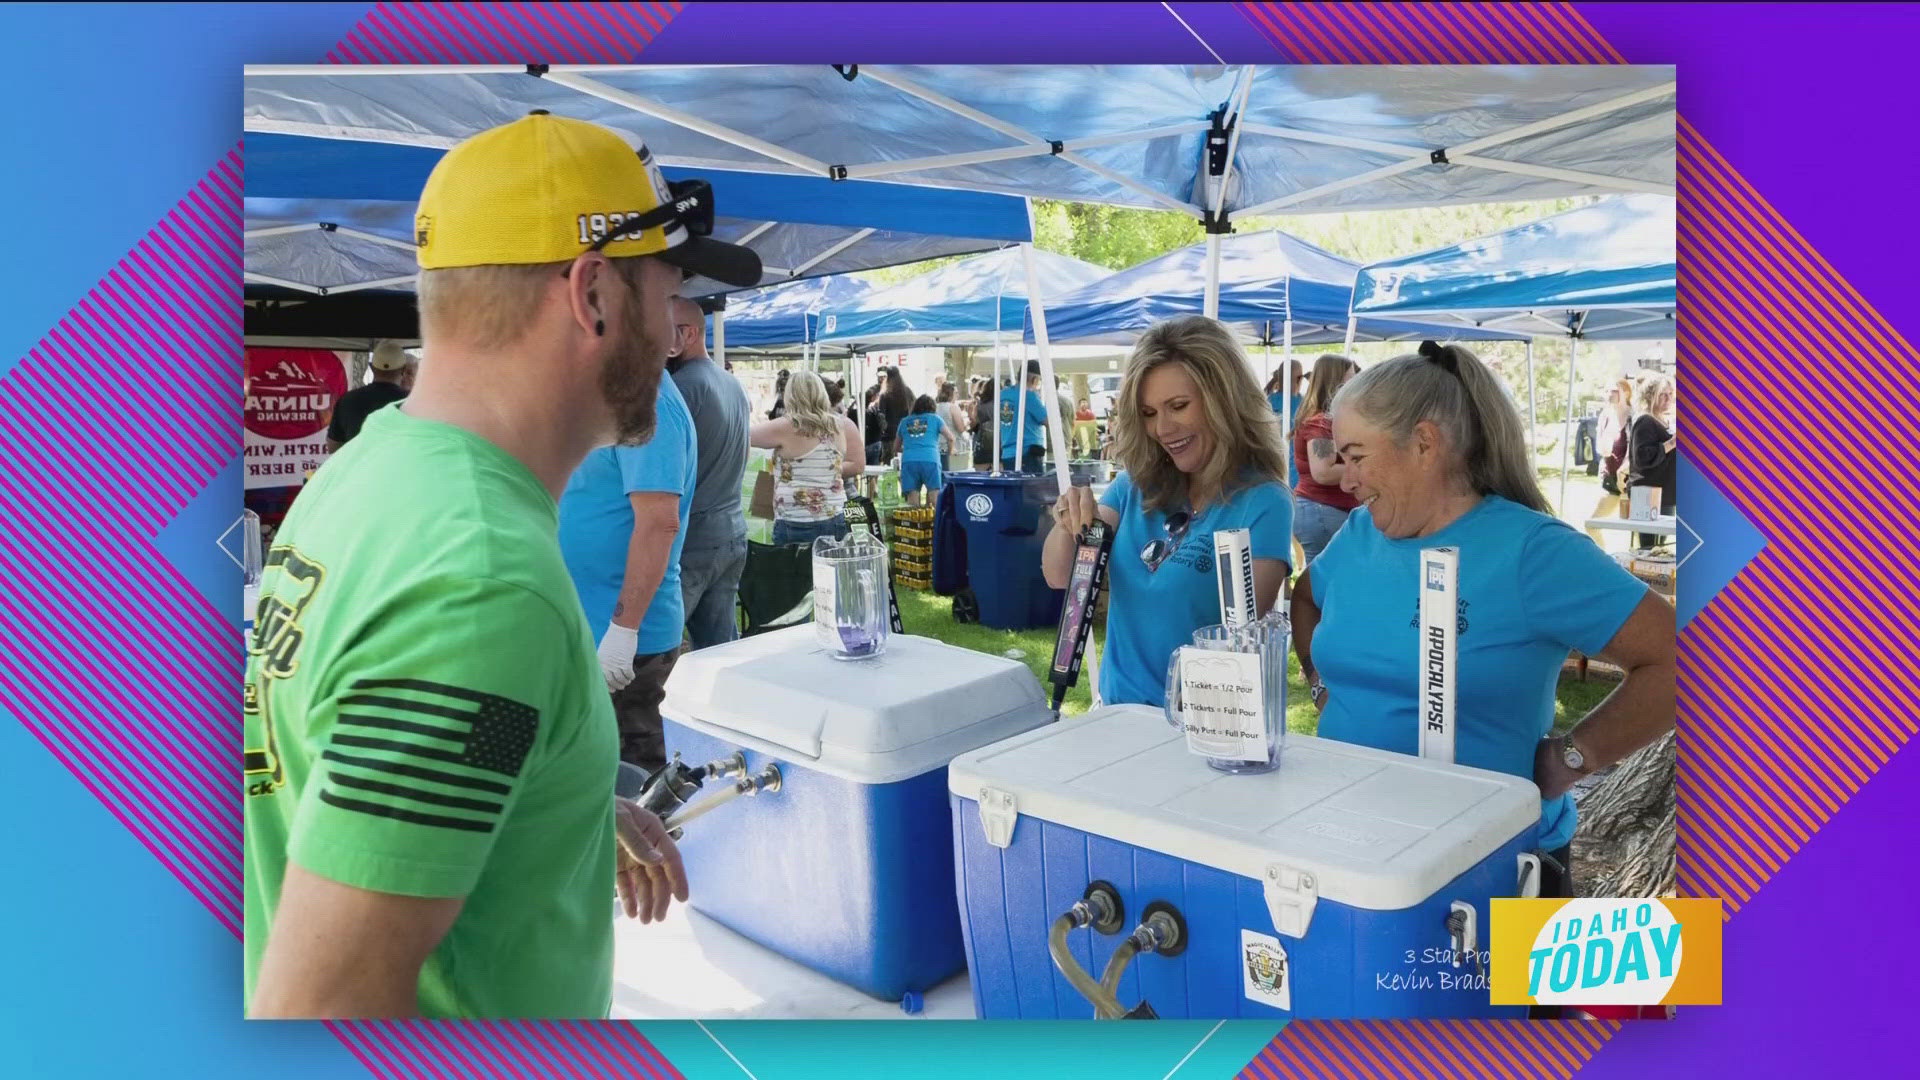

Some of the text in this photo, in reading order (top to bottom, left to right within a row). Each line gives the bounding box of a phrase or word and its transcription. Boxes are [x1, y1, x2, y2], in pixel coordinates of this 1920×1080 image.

[1078, 550, 1096, 562] IPA
[1071, 552, 1108, 672] ELYSIAN
[1427, 625, 1445, 734] APOCALYPSE
[1190, 680, 1212, 690] Ticket
[1222, 684, 1234, 692] 1/2
[1236, 685, 1254, 694] Pour
[1183, 702, 1188, 710] 2
[1224, 706, 1238, 715] Full
[1239, 708, 1257, 717] Pour
[1225, 729, 1239, 738] Full
[1240, 731, 1260, 739] Pour
